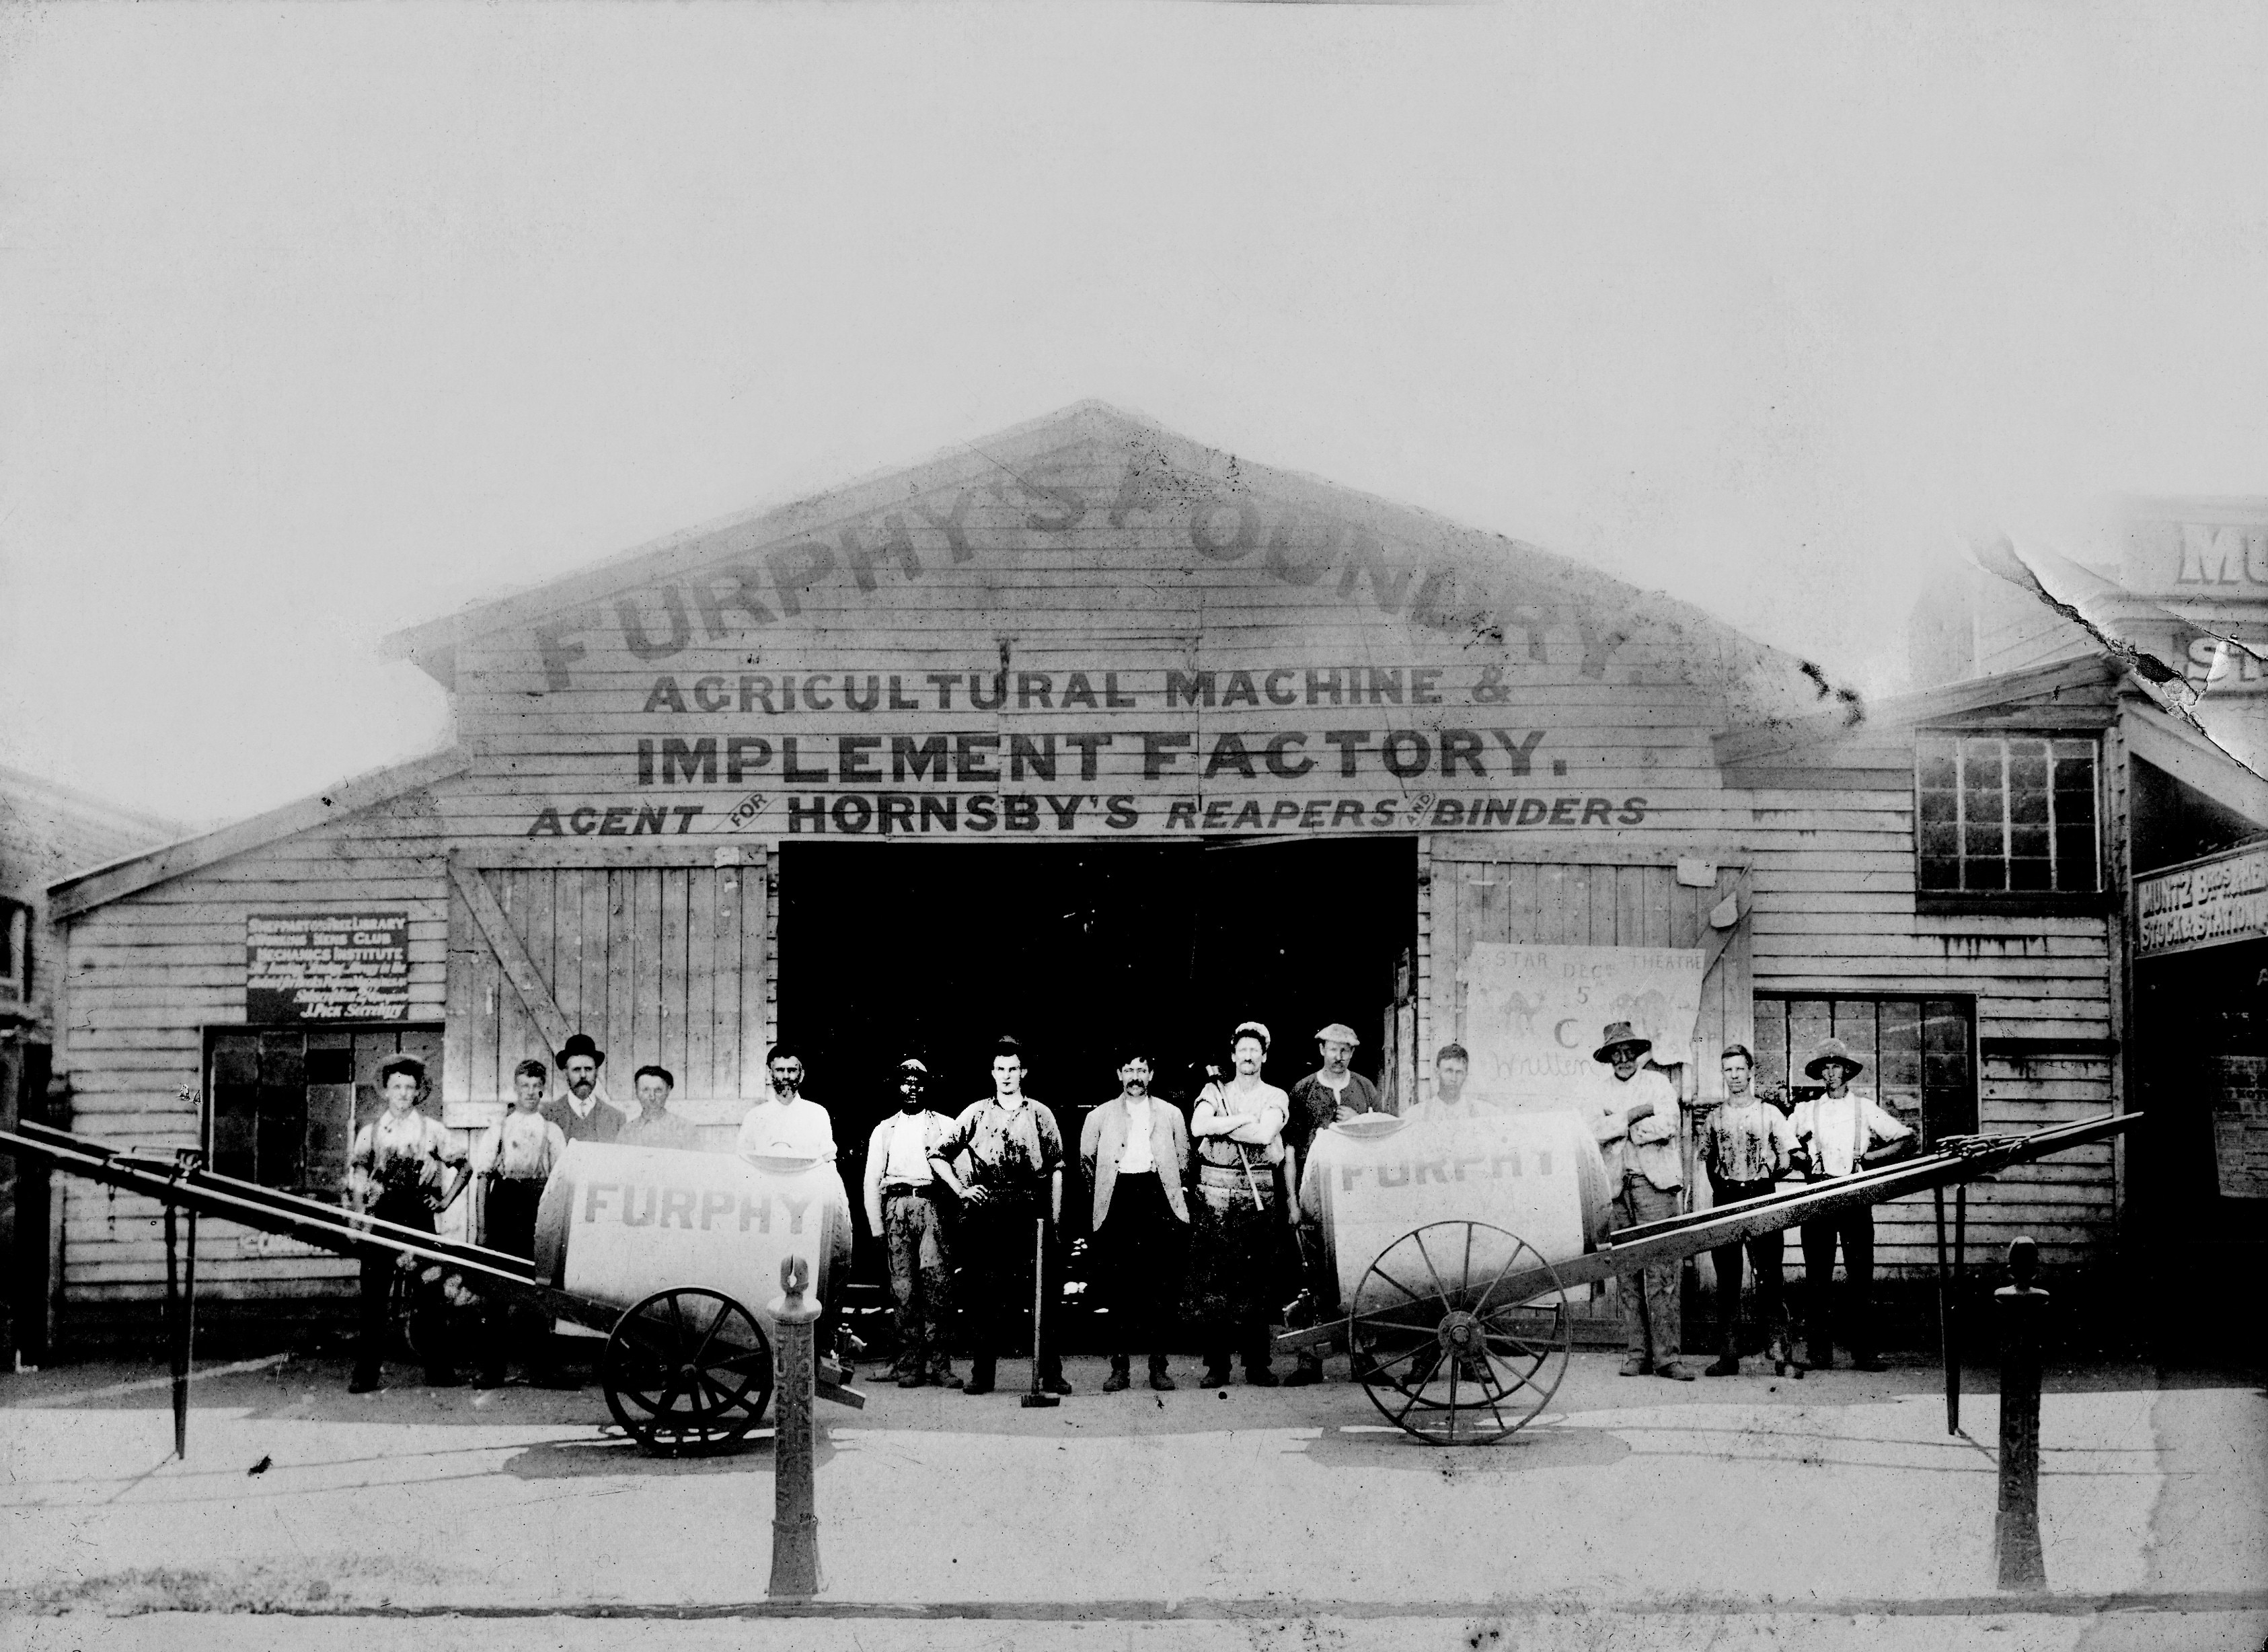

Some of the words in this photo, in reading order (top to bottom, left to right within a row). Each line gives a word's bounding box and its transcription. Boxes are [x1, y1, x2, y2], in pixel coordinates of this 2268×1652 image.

[536, 469, 1086, 691] FURPHY'S
[642, 673, 1136, 714] AGRICULTURAL
[1166, 671, 1443, 708] MACHINE
[1472, 668, 1511, 703] &
[638, 735, 1112, 785] IMPLEMENT
[1143, 729, 1567, 781] FACTORY.
[527, 806, 703, 836] AGENT
[730, 791, 767, 827] FOR
[788, 794, 1139, 834] HORNSBY'S
[1166, 799, 1398, 829] REAPERS
[1430, 796, 1649, 826] BINDERS
[353, 915, 405, 930] LIBRARY
[257, 947, 332, 962] MECHANICS
[334, 946, 404, 961] INSTITUTE
[353, 932, 391, 945] CLUB
[1496, 950, 1547, 967] STAR
[1631, 953, 1702, 970] THEATRE
[1554, 1018, 1579, 1049] C
[1488, 1049, 1599, 1077] Written
[584, 1180, 810, 1235] FURPHY
